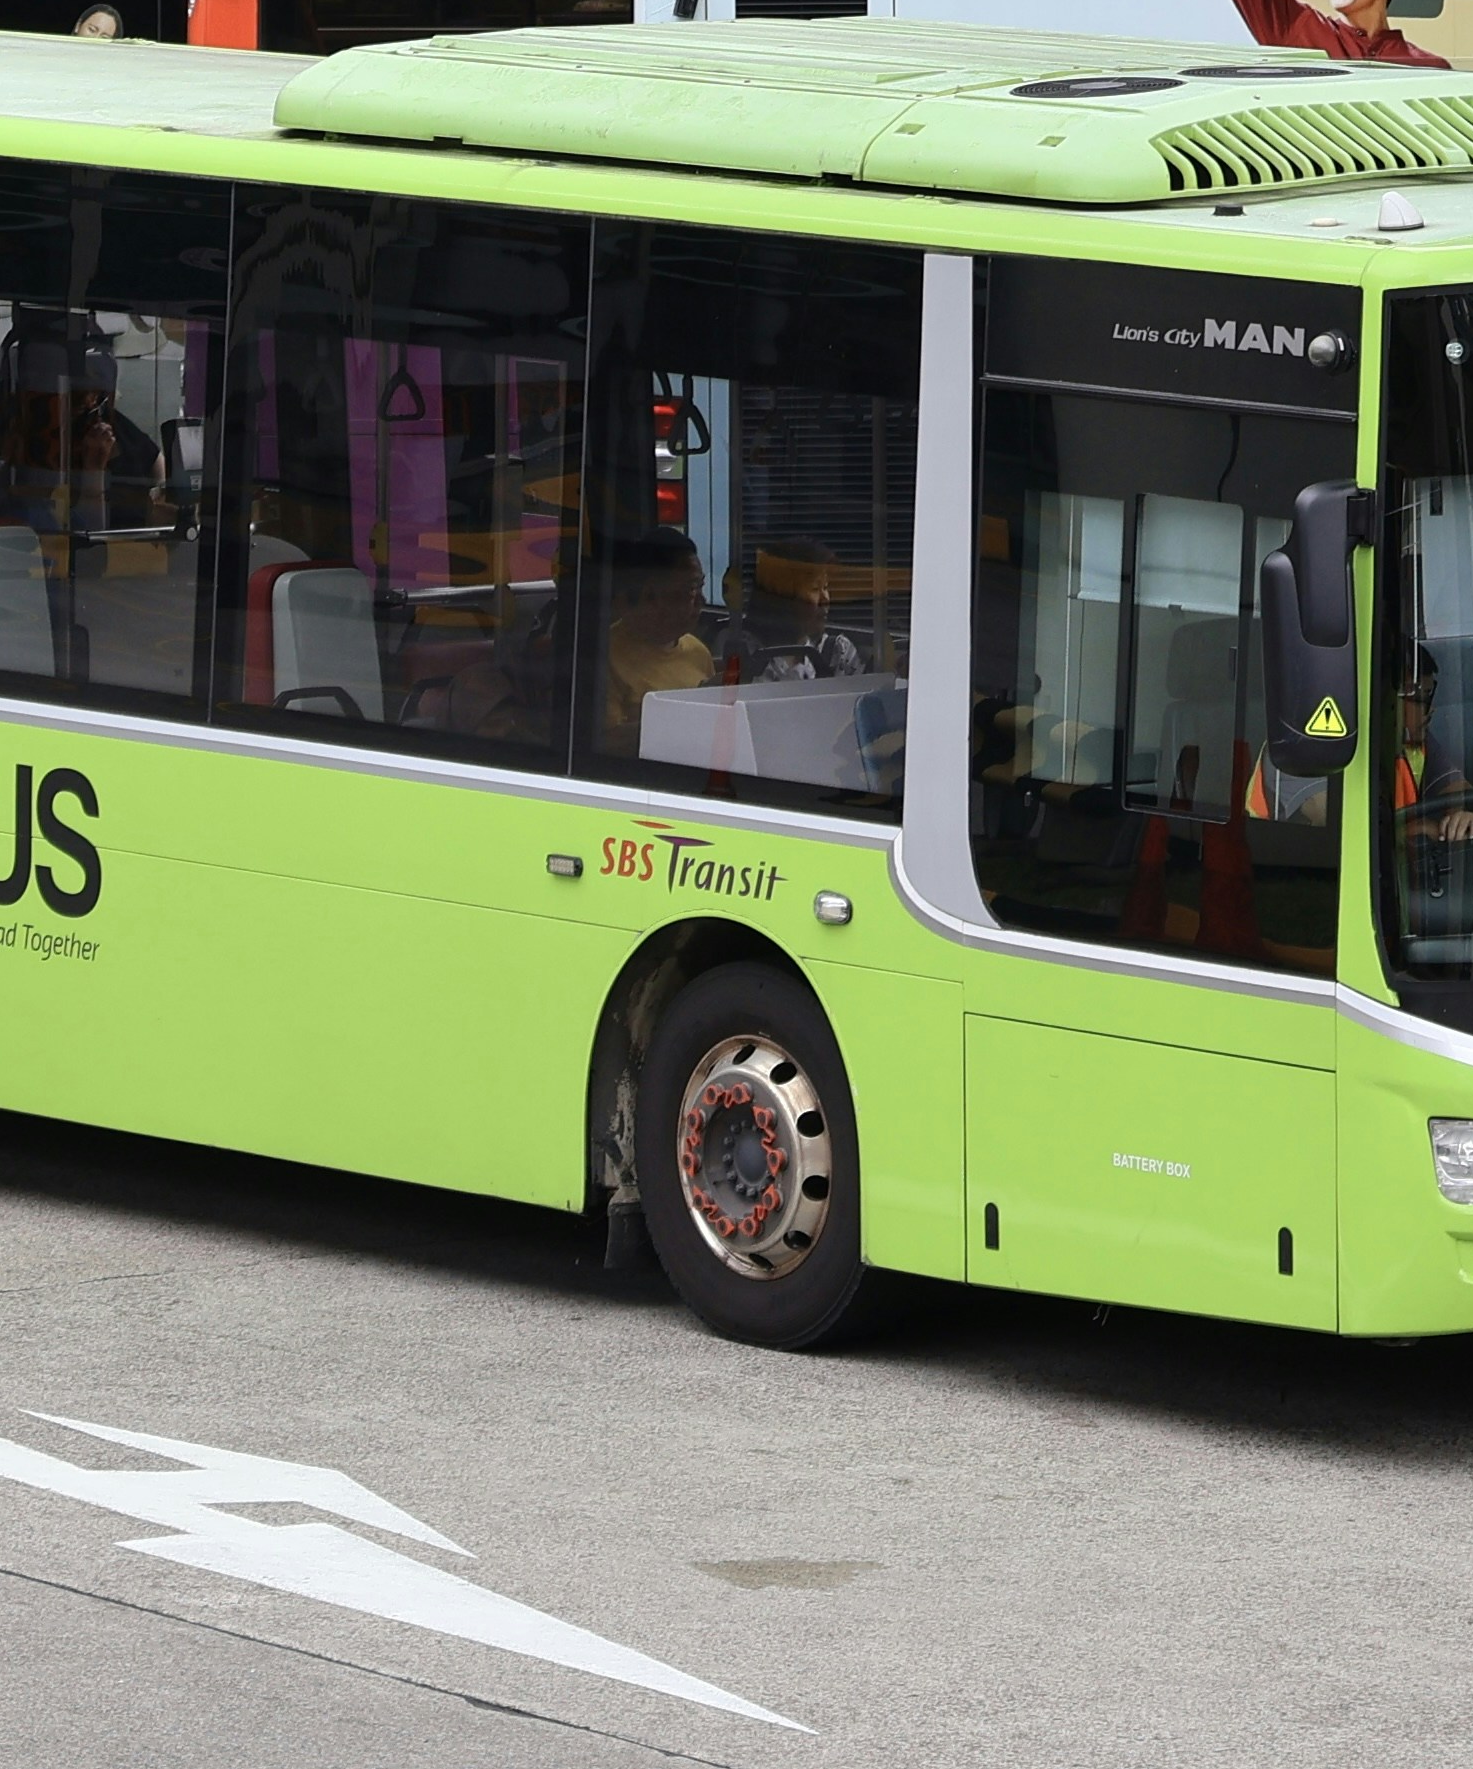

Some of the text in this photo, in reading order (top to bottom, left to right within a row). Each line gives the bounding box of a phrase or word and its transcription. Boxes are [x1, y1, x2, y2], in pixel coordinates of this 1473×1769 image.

[1112, 318, 1305, 358] Lion's City MAN
[599, 834, 789, 901] SBS Transit
[22, 923, 101, 963] Together
[1112, 1152, 1191, 1178] BATTERY BOX
